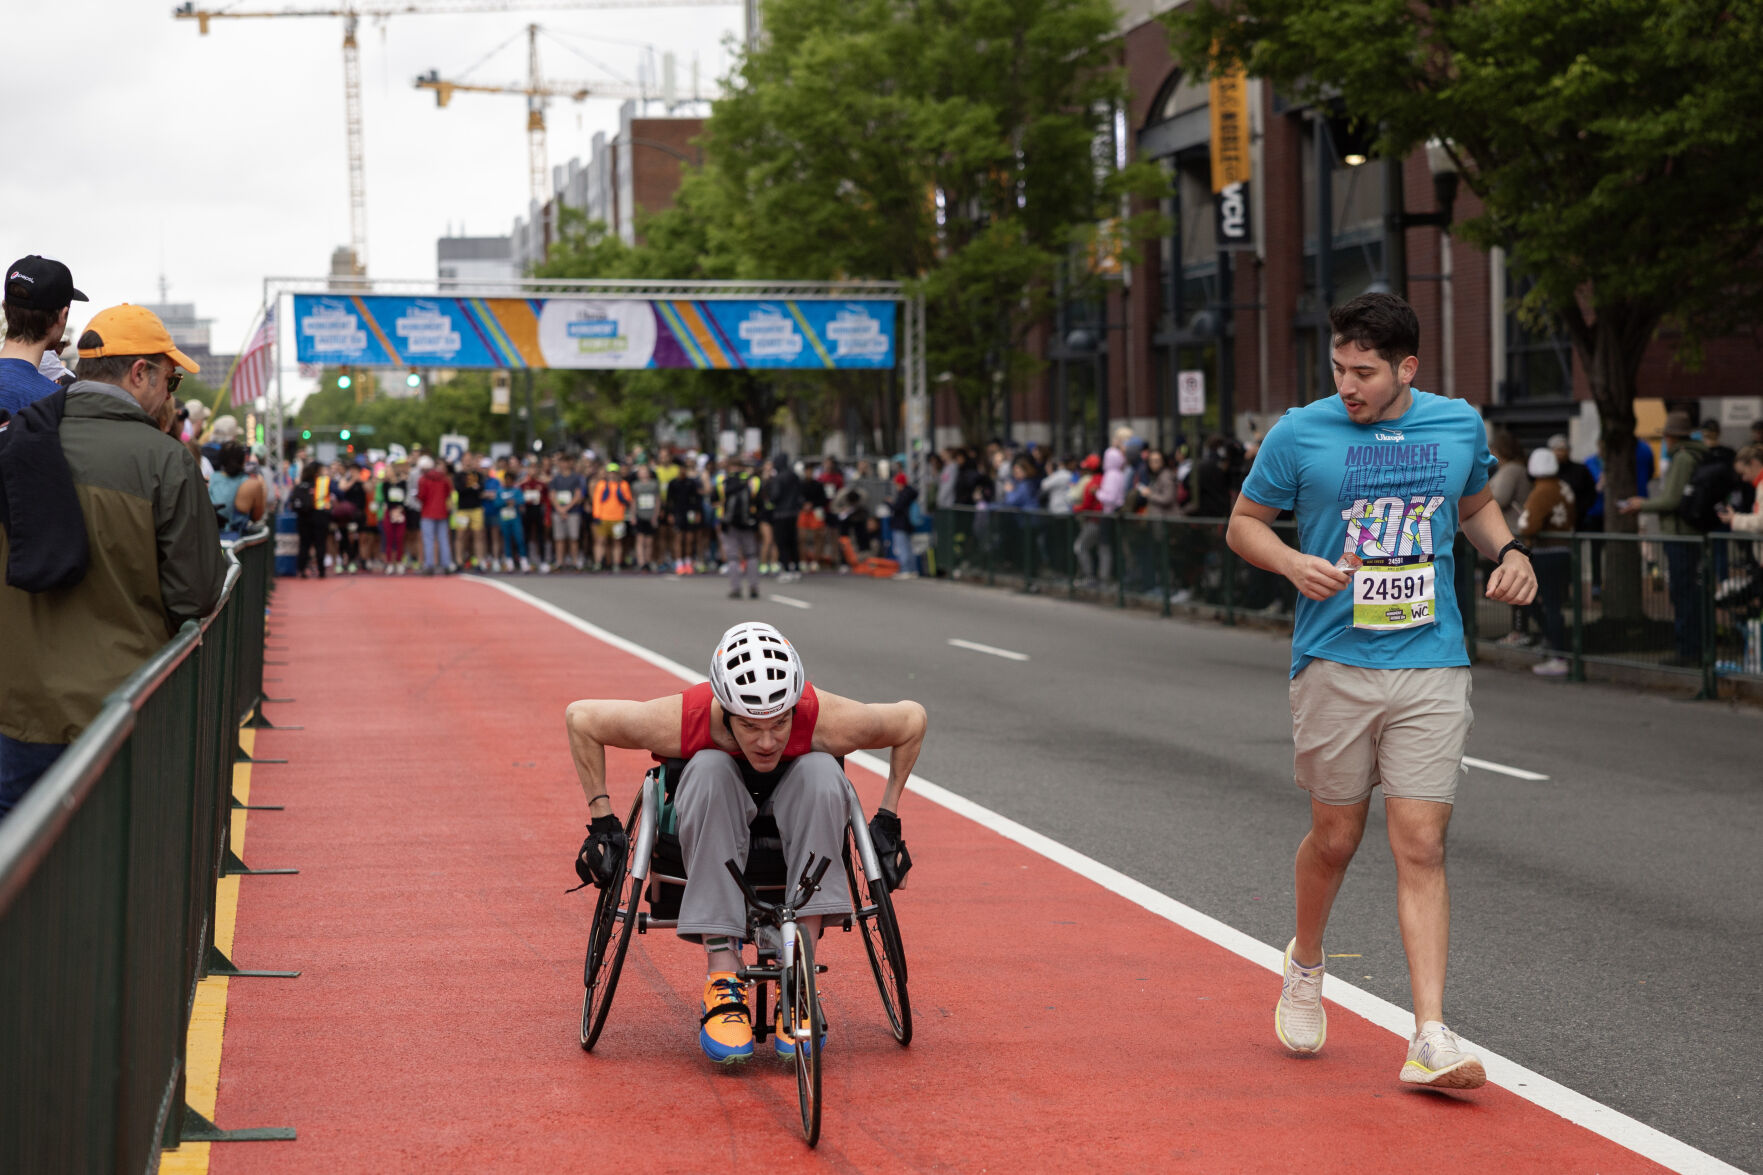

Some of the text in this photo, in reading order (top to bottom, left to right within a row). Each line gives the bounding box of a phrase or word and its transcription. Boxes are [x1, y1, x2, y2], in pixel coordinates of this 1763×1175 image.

[1221, 181, 1245, 238] VCU
[1345, 443, 1440, 467] MONUMENT
[1338, 461, 1449, 503] AVENUE
[1341, 496, 1445, 557] 10K
[1362, 574, 1425, 601] 24591
[1411, 606, 1430, 620] WC
